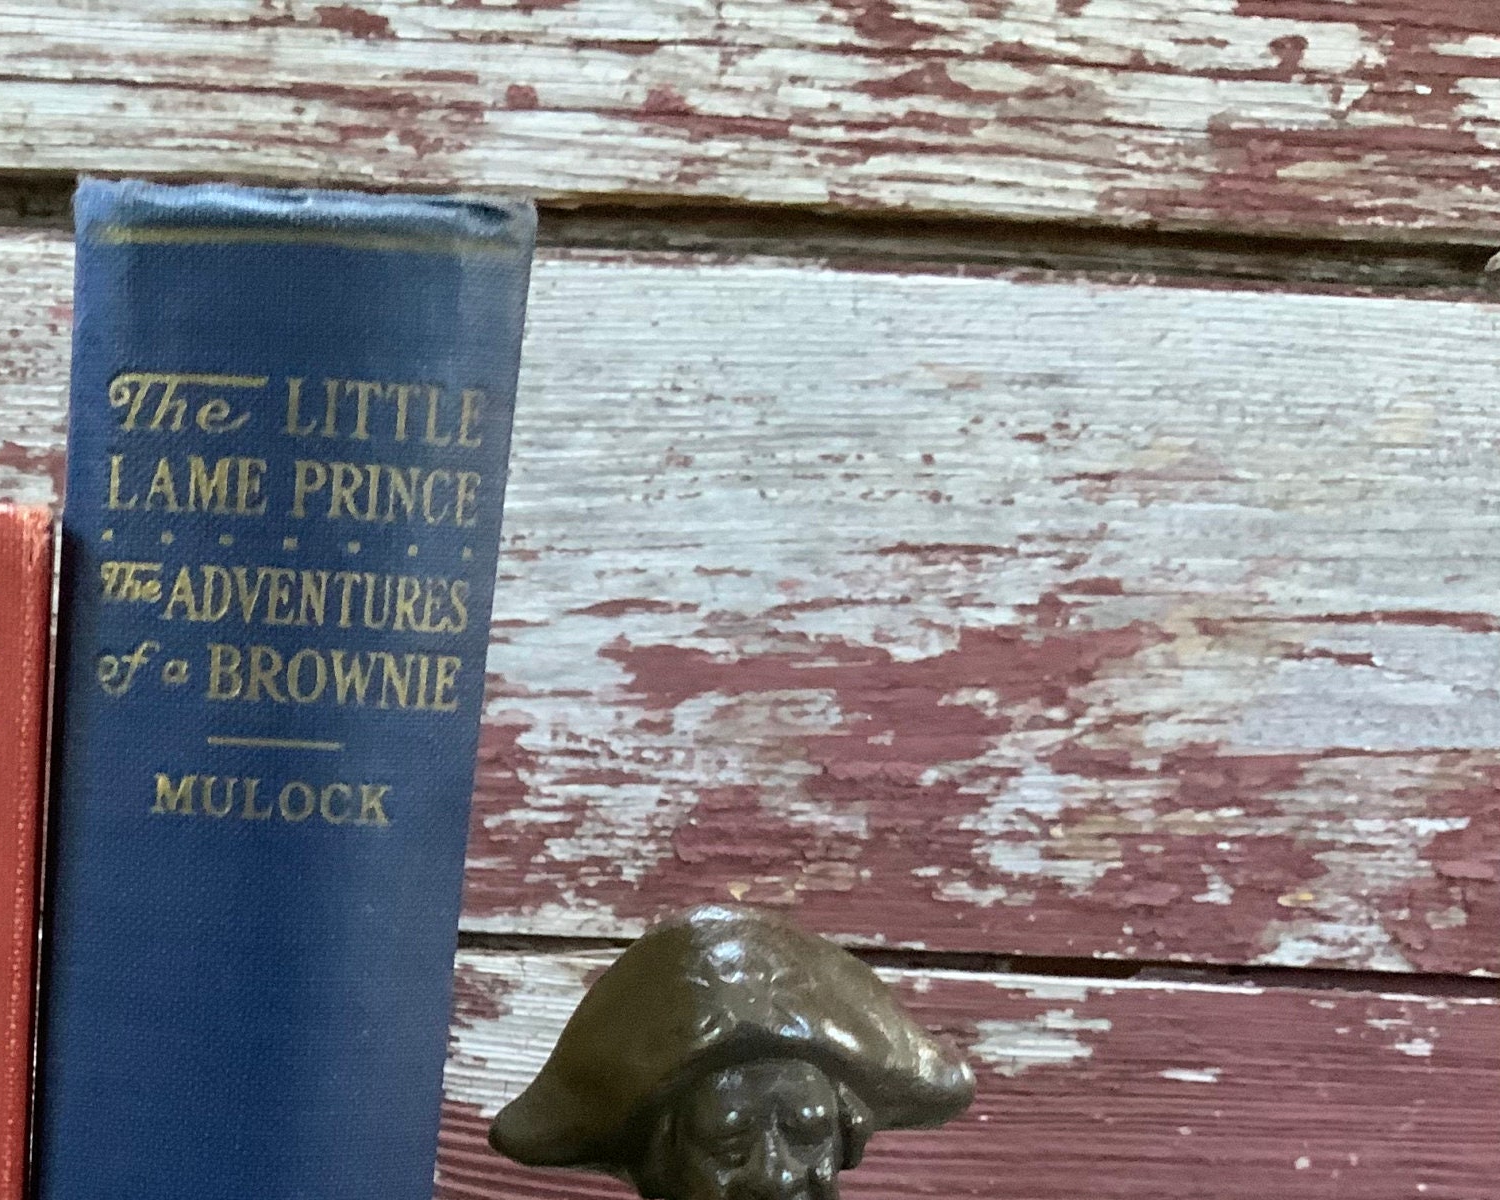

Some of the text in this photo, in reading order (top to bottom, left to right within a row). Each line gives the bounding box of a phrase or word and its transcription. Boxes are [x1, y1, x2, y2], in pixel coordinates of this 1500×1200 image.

[109, 373, 484, 449] The LITTLE
[106, 453, 483, 527] LAME PRINCE
[100, 560, 470, 635] The ADVENTURES
[99, 640, 463, 713] of a BROWNIE
[151, 772, 394, 828] MULOCK
